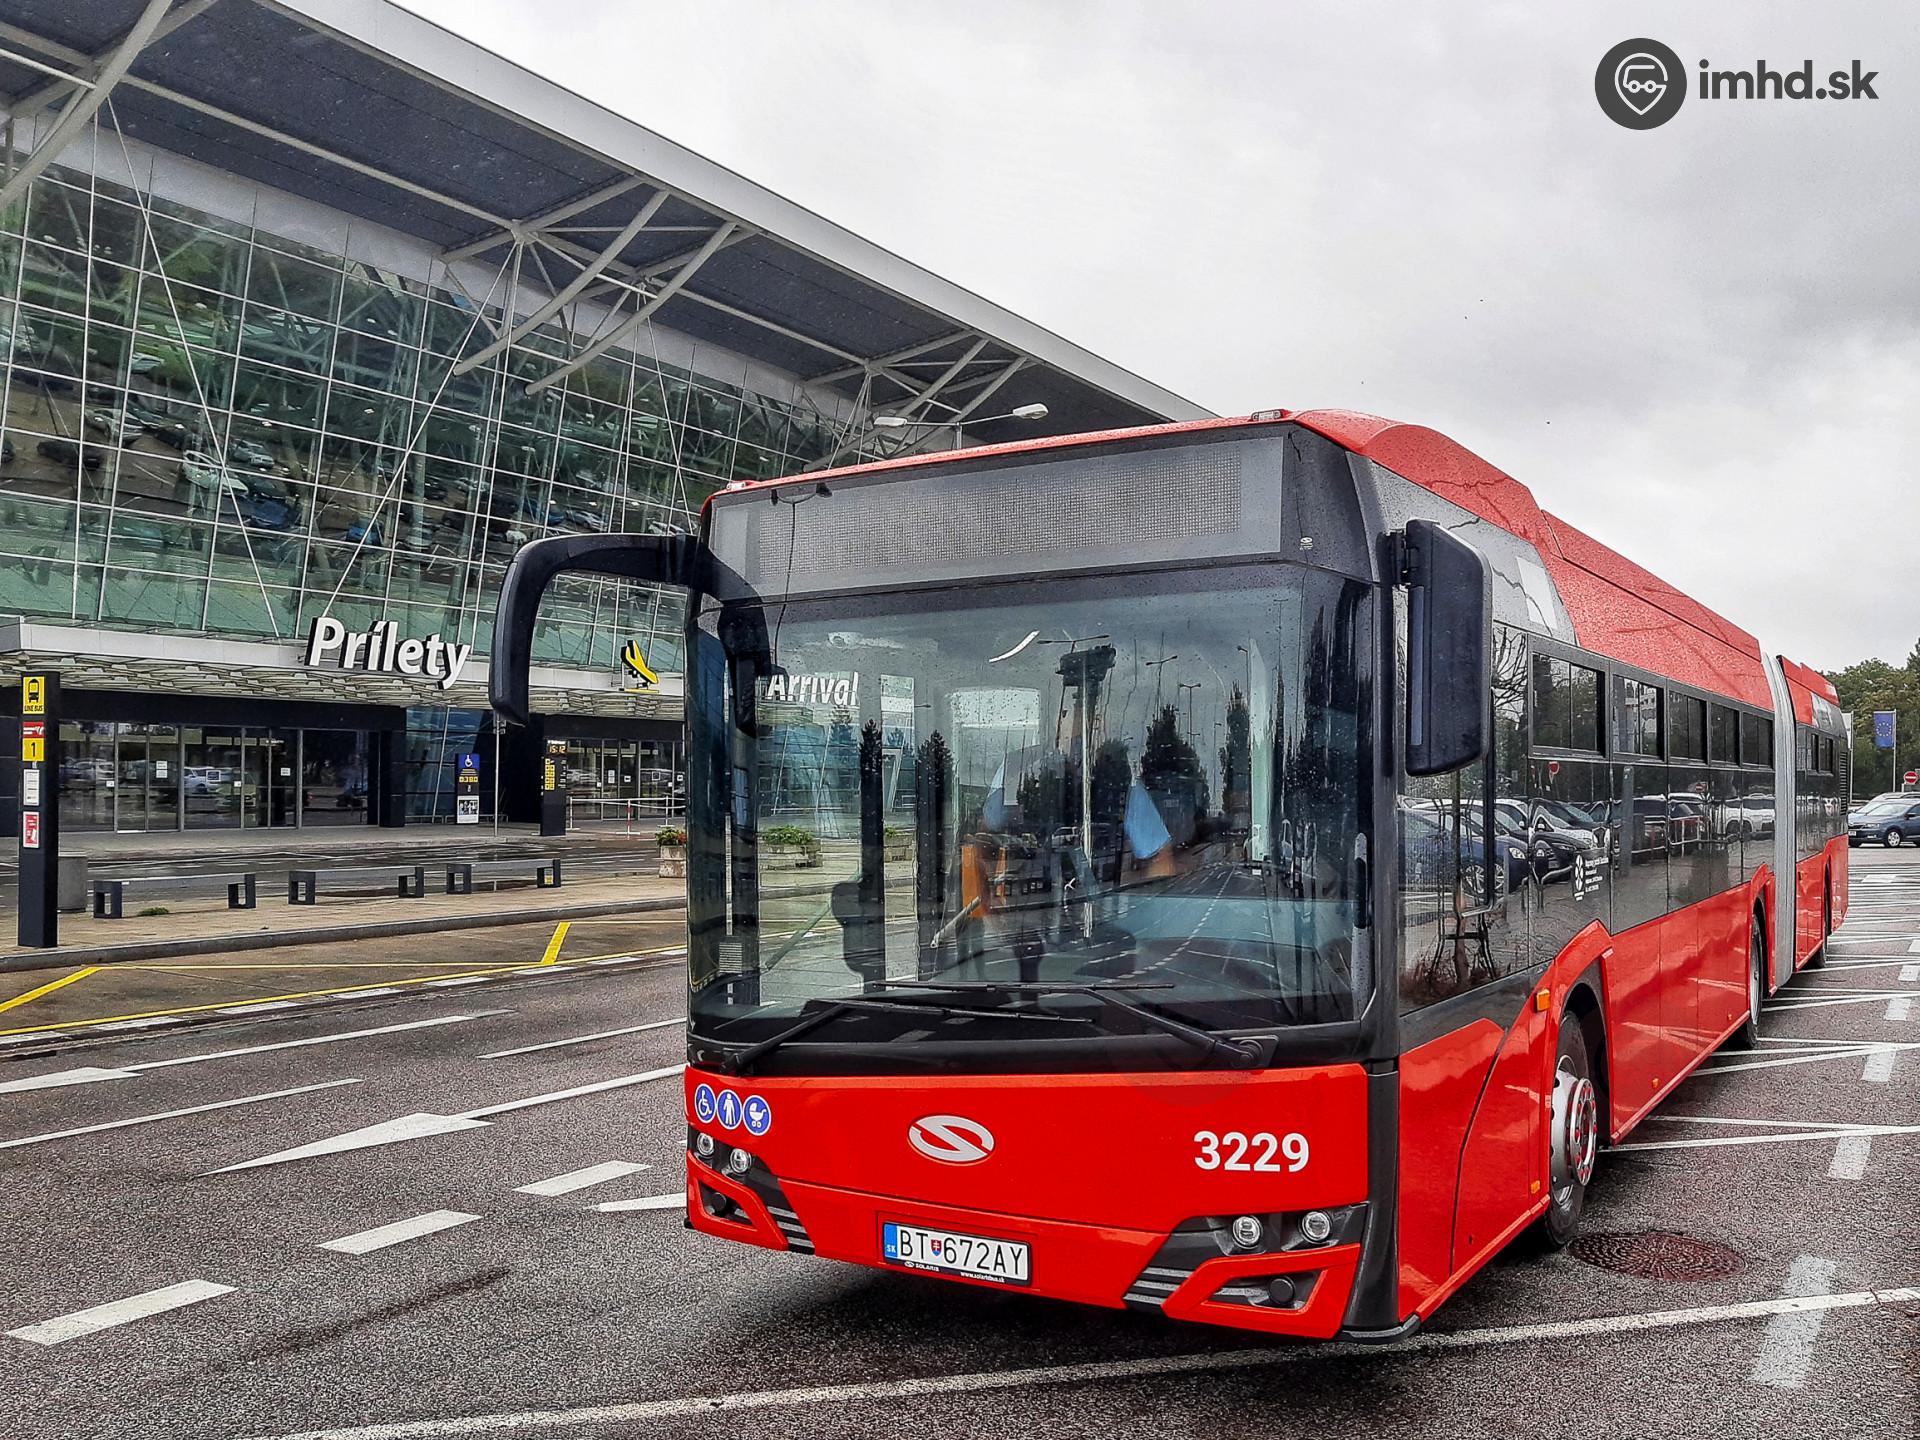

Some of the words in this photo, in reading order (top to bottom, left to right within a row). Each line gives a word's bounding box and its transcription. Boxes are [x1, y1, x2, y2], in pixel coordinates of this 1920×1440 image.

[304, 617, 471, 690] Prílety
[31, 742, 36, 757] 1
[1194, 1131, 1309, 1172] 3229
[886, 1244, 897, 1253] SK
[915, 1263, 940, 1272] SOLARIS
